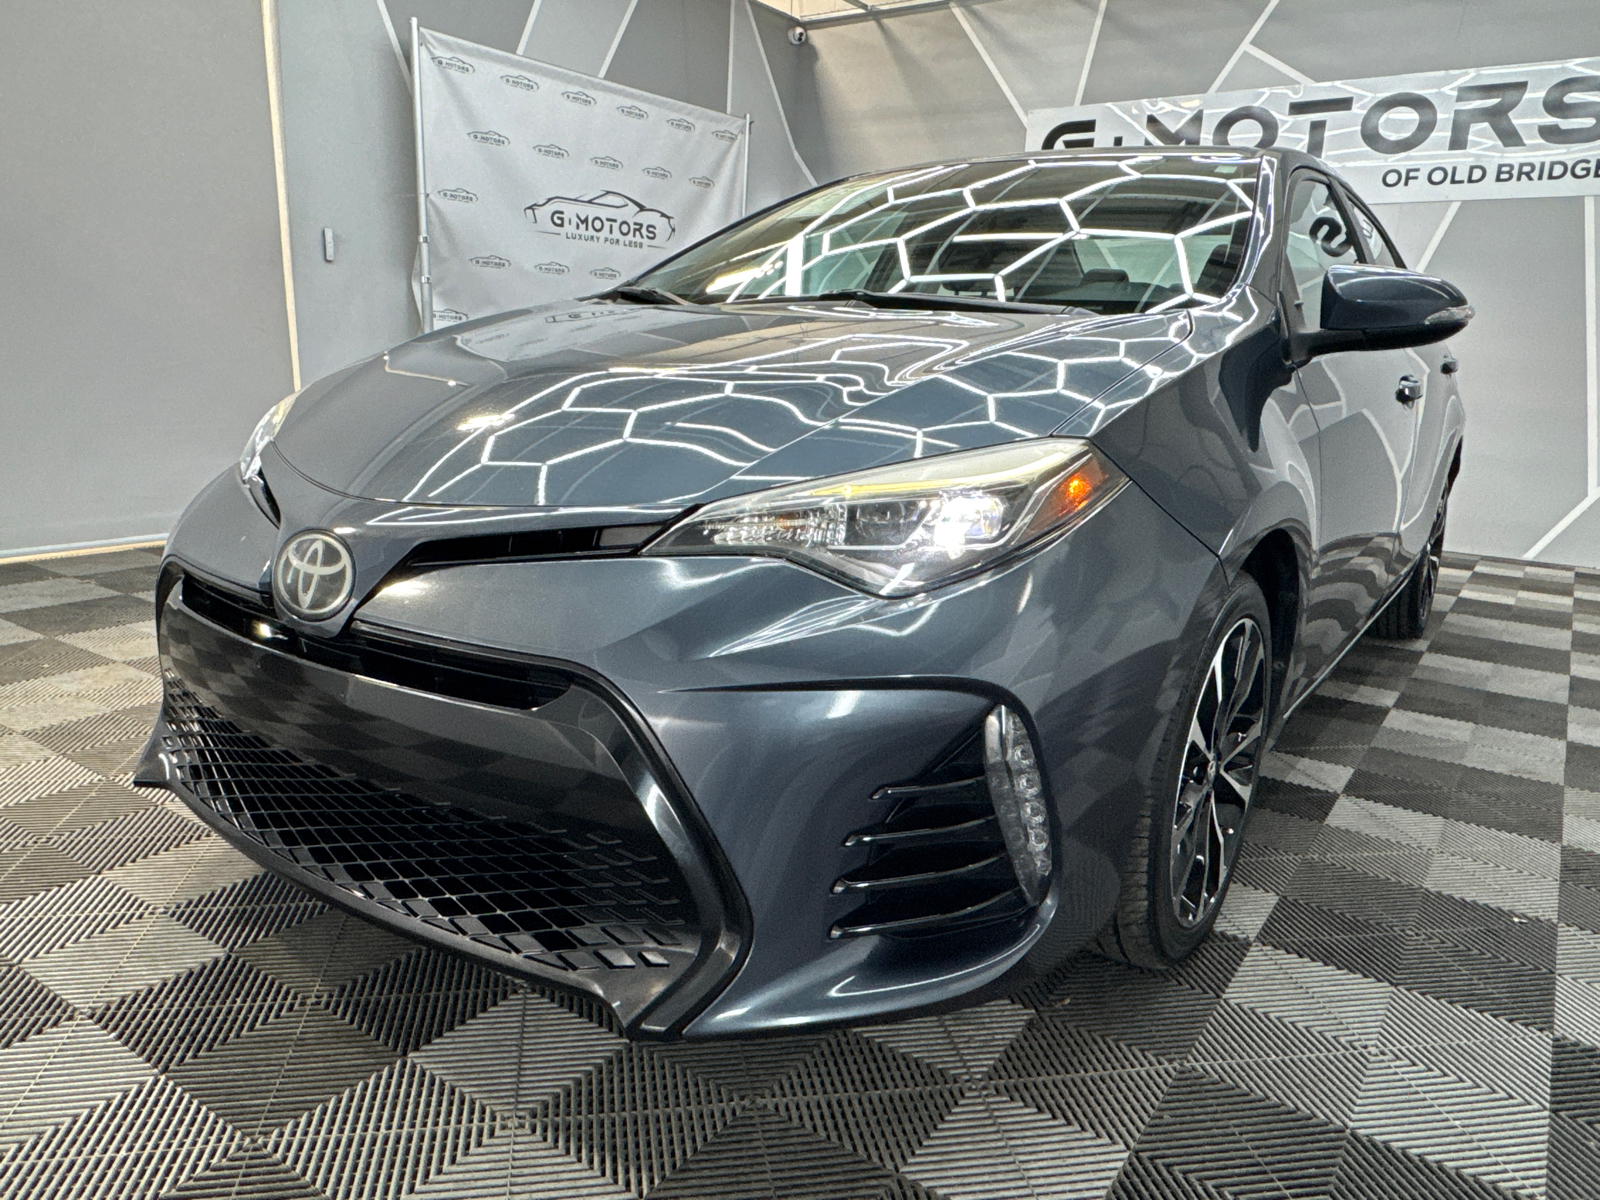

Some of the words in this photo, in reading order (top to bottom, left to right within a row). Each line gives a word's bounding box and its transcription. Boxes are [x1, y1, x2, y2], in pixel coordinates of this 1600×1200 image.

[1381, 167, 1421, 188] OF
[1427, 164, 1487, 186] OLD
[566, 231, 600, 243] LUXURY
[604, 236, 620, 246] FOR
[623, 240, 644, 249] LESS
